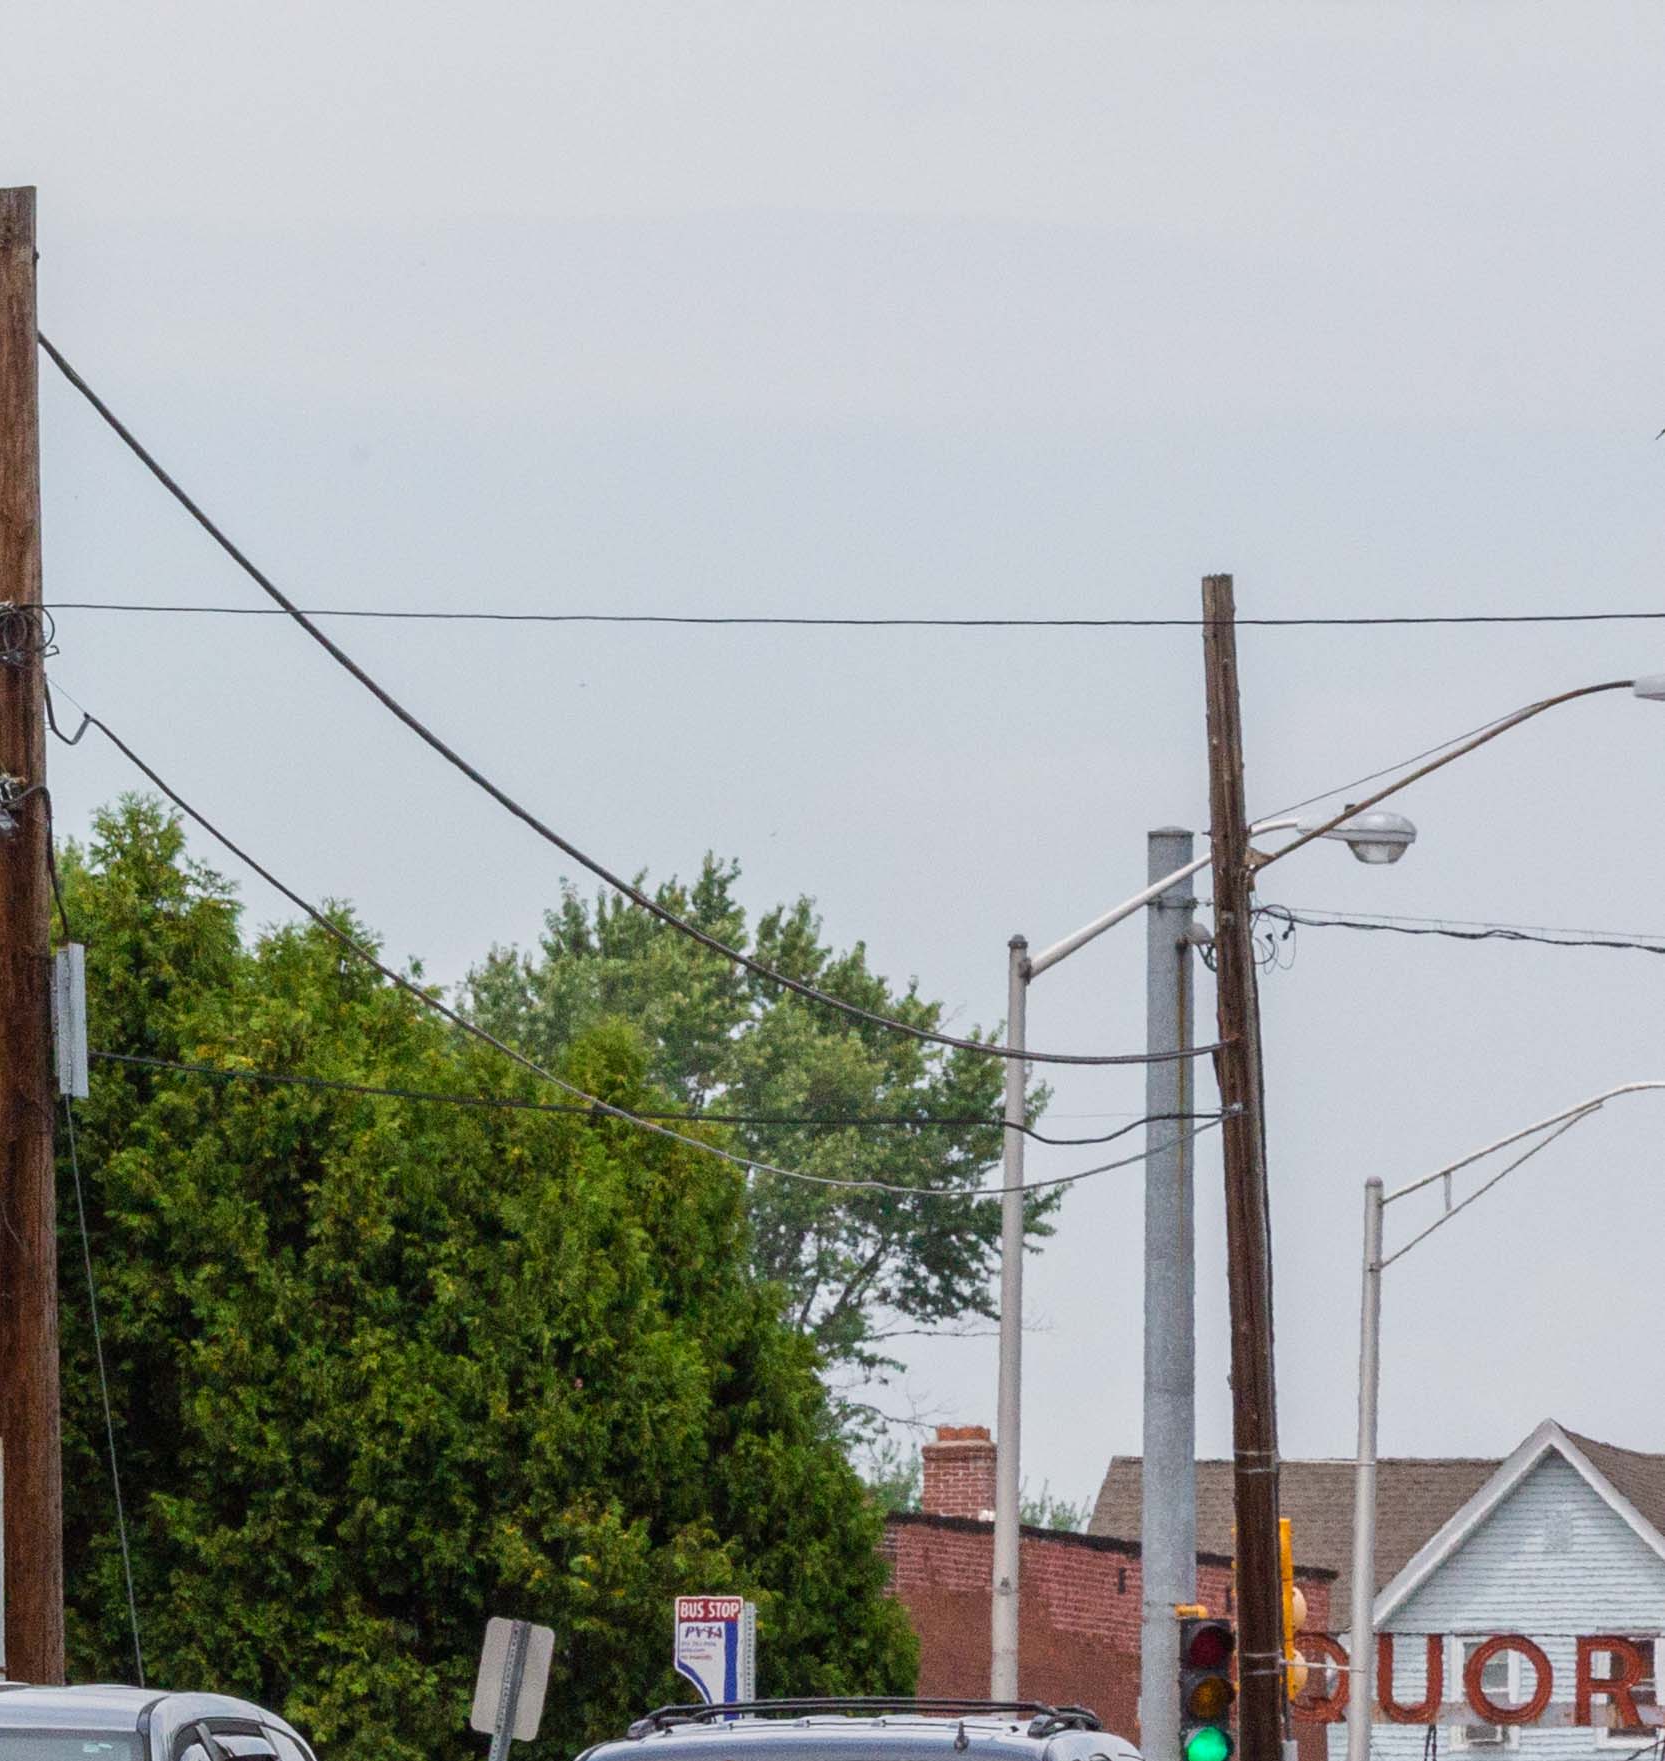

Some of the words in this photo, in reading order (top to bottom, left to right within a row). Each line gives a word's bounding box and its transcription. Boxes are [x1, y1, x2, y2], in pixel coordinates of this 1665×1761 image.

[680, 1601, 704, 1618] BUS
[708, 1602, 740, 1619] STOP
[1285, 1631, 1645, 1728] QUOR
